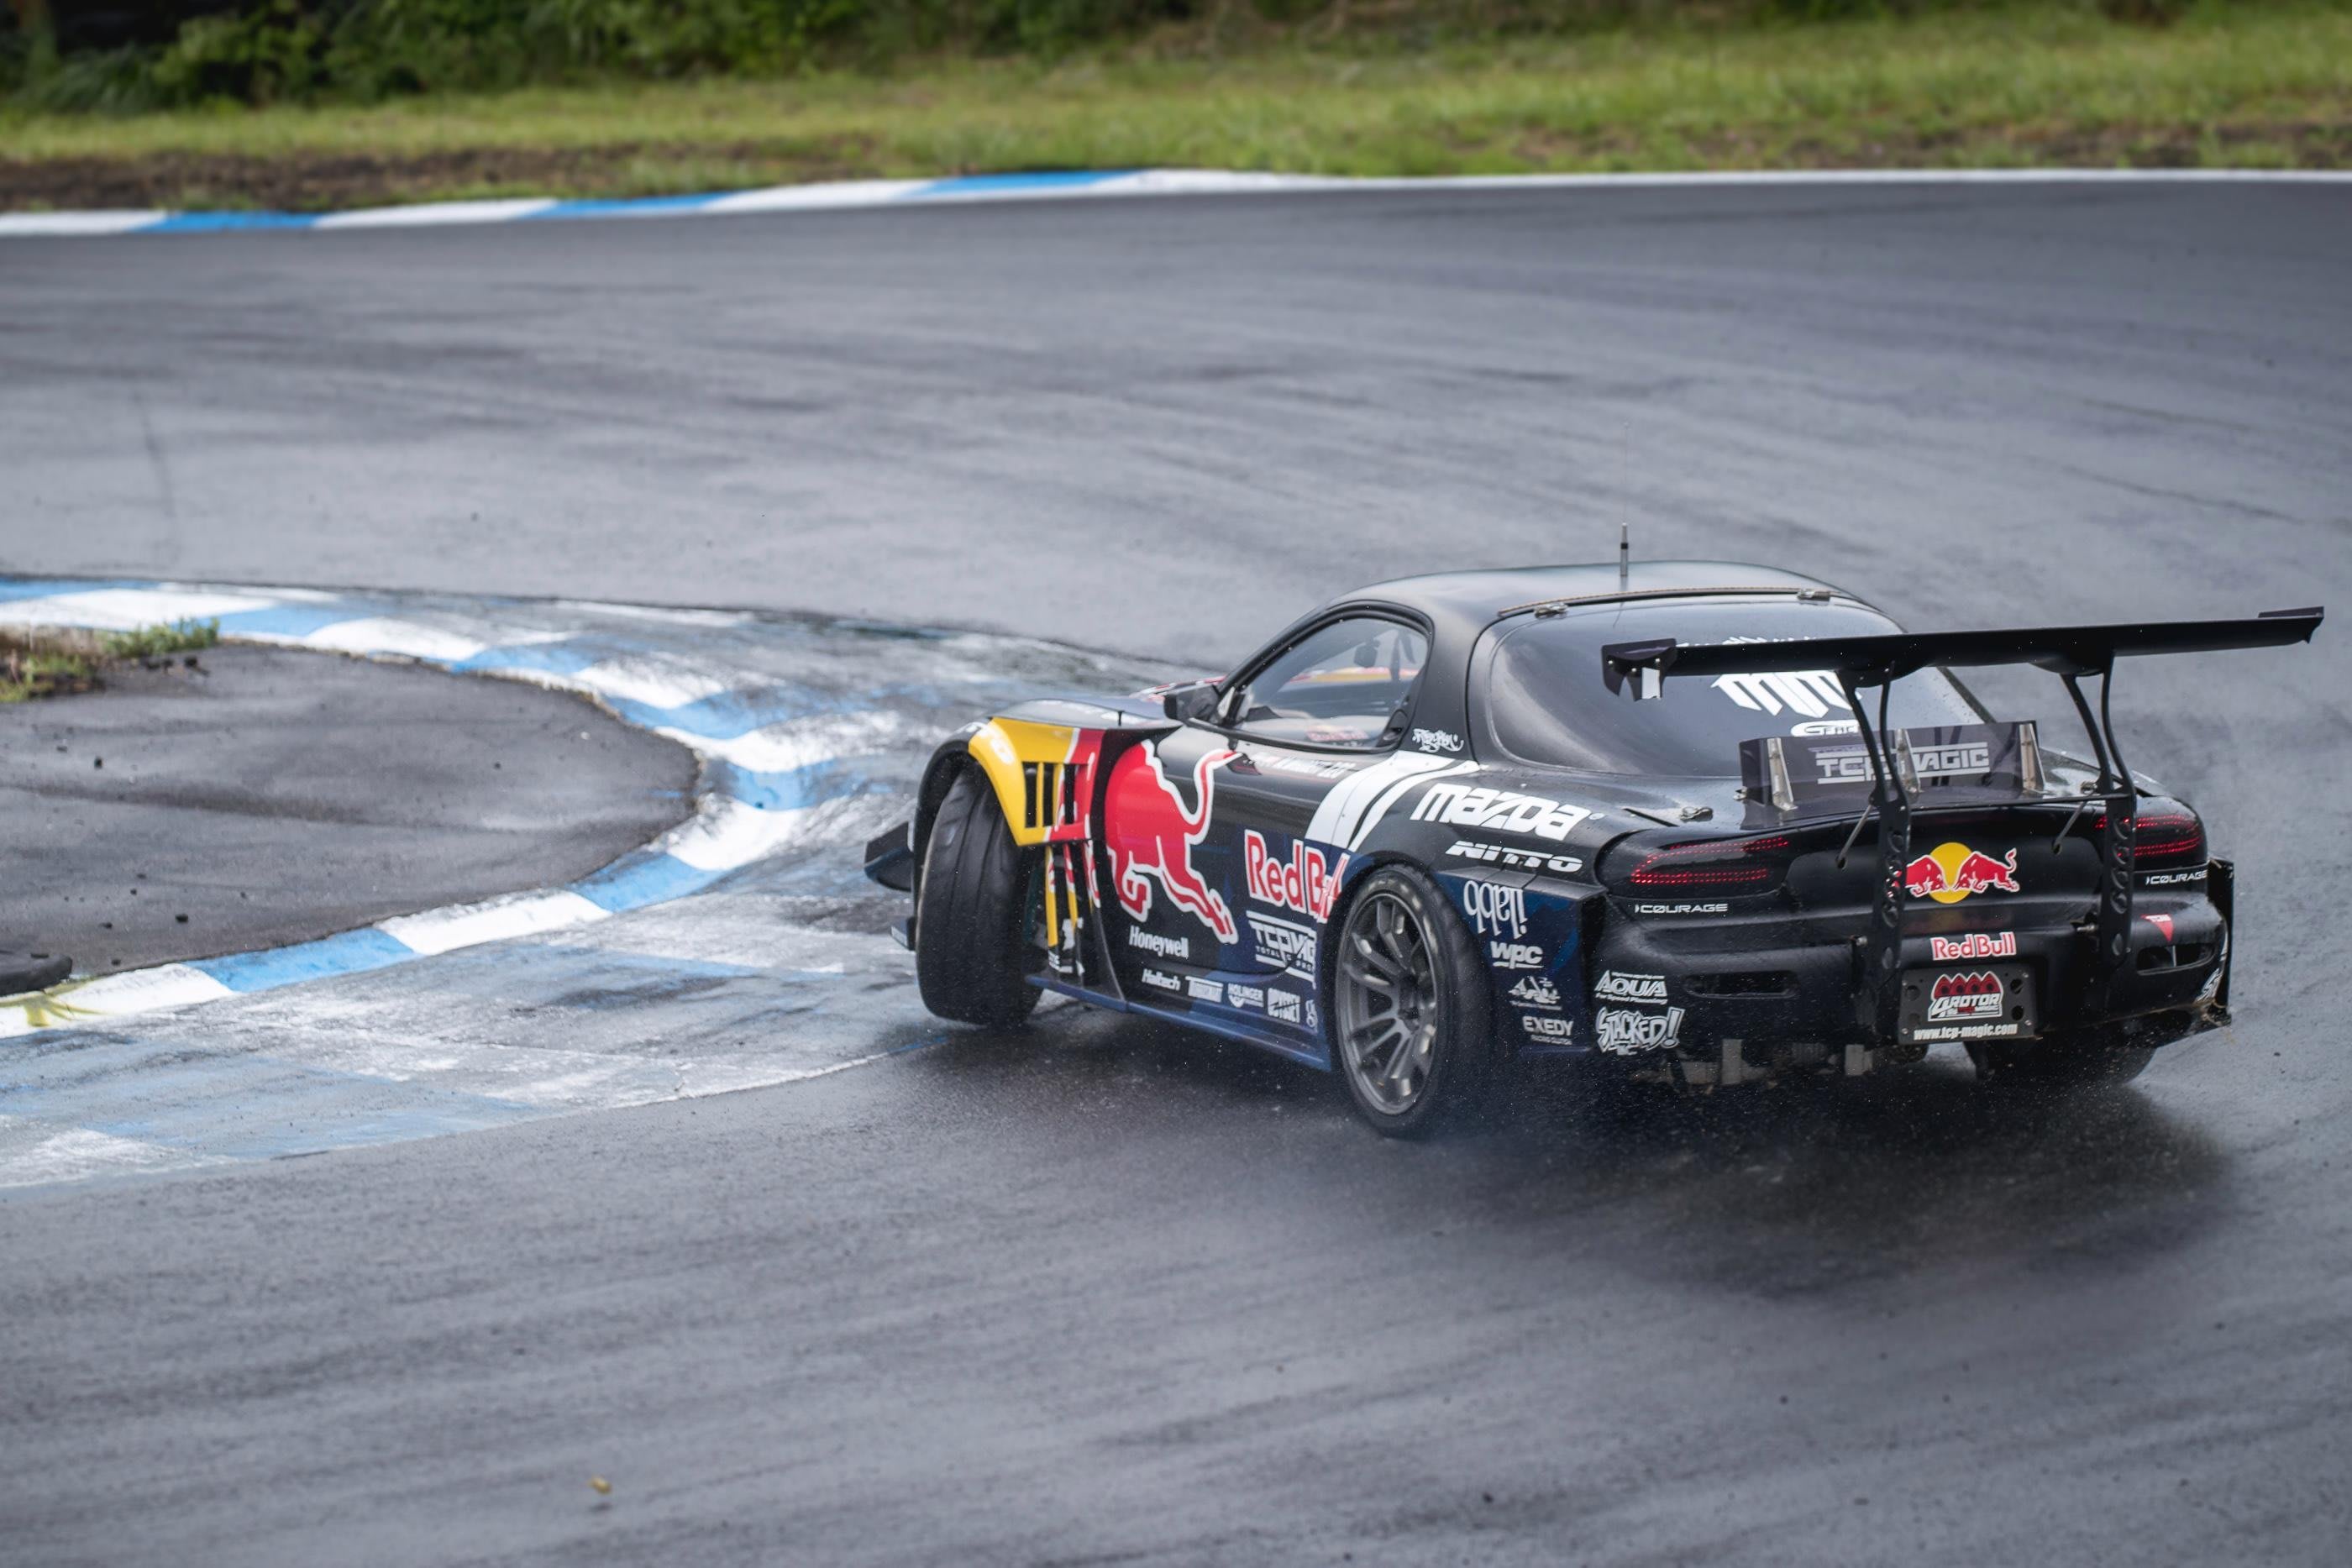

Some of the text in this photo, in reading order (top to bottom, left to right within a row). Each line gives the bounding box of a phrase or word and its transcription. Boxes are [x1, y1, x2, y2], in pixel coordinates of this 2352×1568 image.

[1244, 828, 1307, 915] Red
[1445, 840, 1583, 873] NITTO
[1129, 925, 1189, 959] Honeywell
[1930, 931, 2017, 961] Red Bull
[1594, 970, 1667, 997] AQUA
[1522, 1015, 1574, 1036] EXEDY
[1914, 1023, 2019, 1041] www.tcp-magic.com
